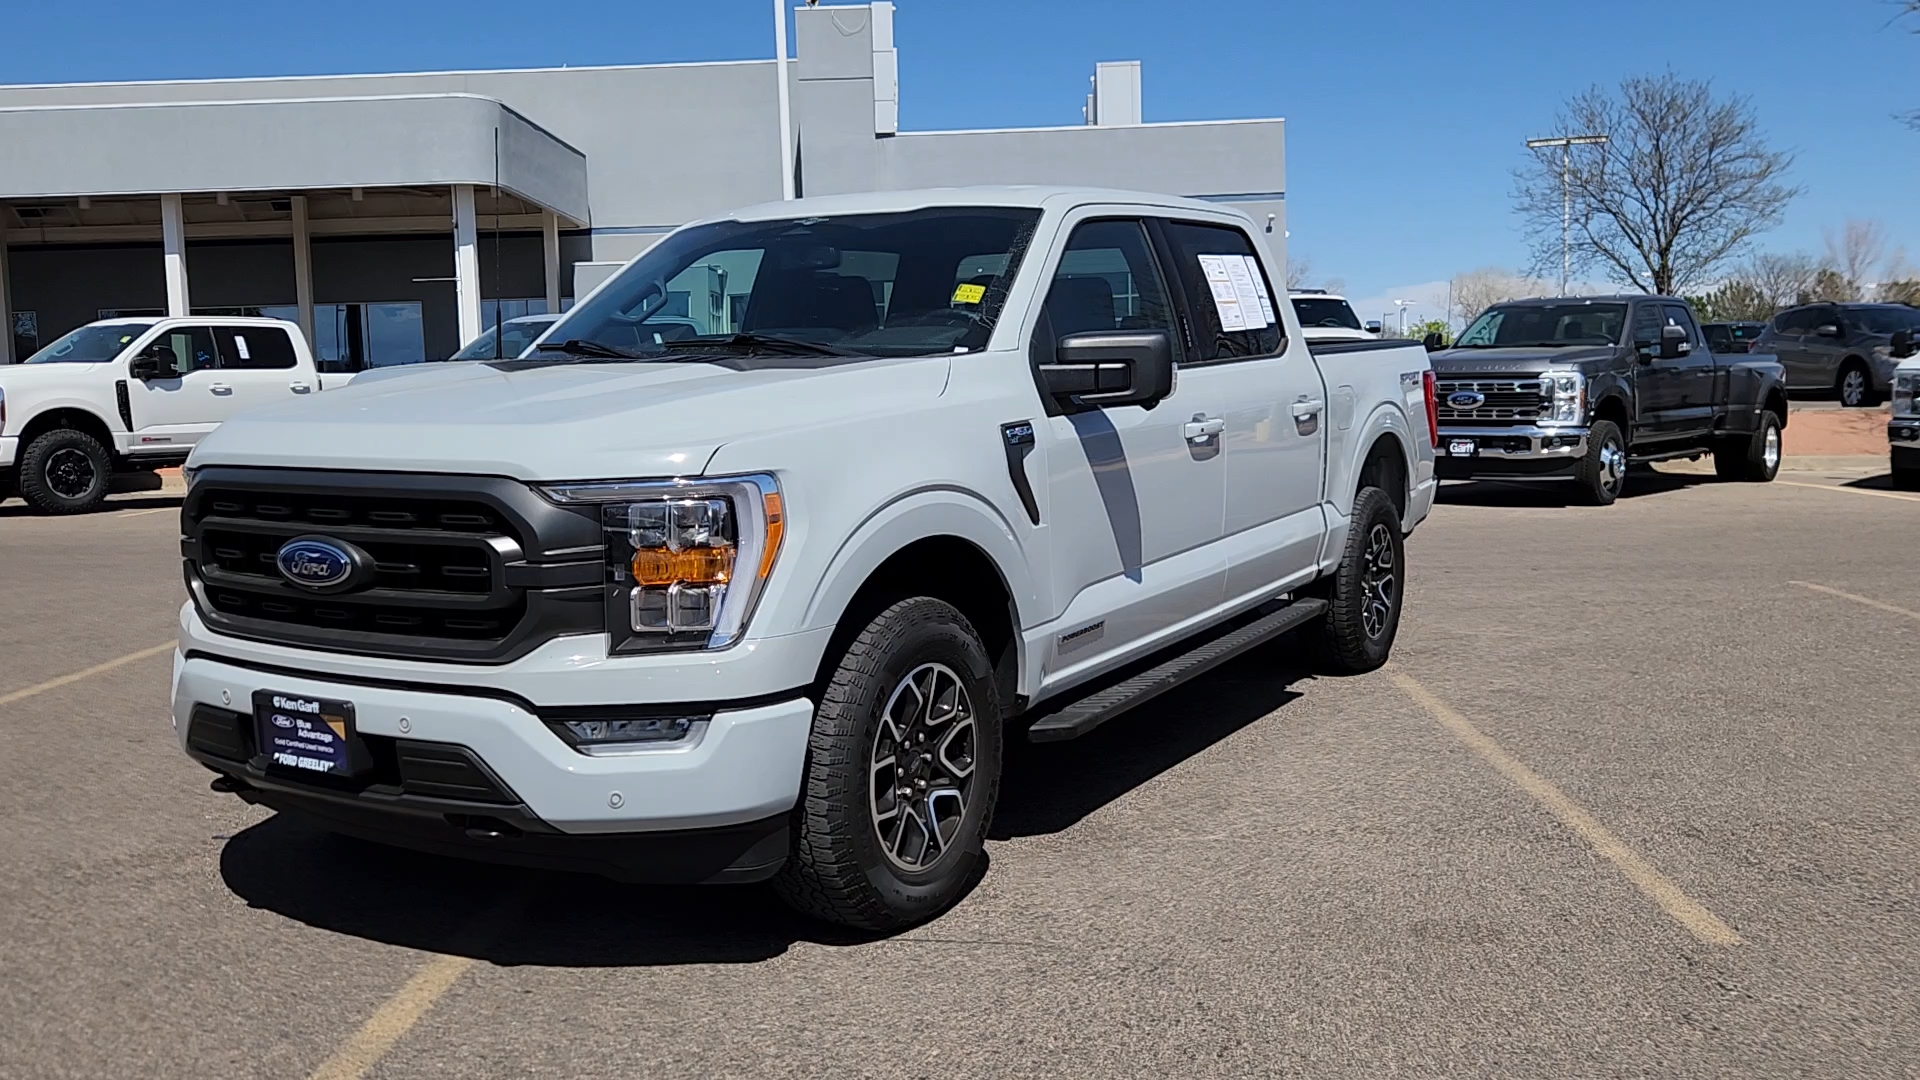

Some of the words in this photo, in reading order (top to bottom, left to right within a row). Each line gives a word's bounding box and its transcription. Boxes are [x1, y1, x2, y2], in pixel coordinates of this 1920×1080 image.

[1450, 442, 1474, 453] Garff
[291, 550, 331, 576] Ford
[280, 697, 297, 711] Ken
[297, 700, 319, 713] Garff
[296, 719, 312, 730] Blue
